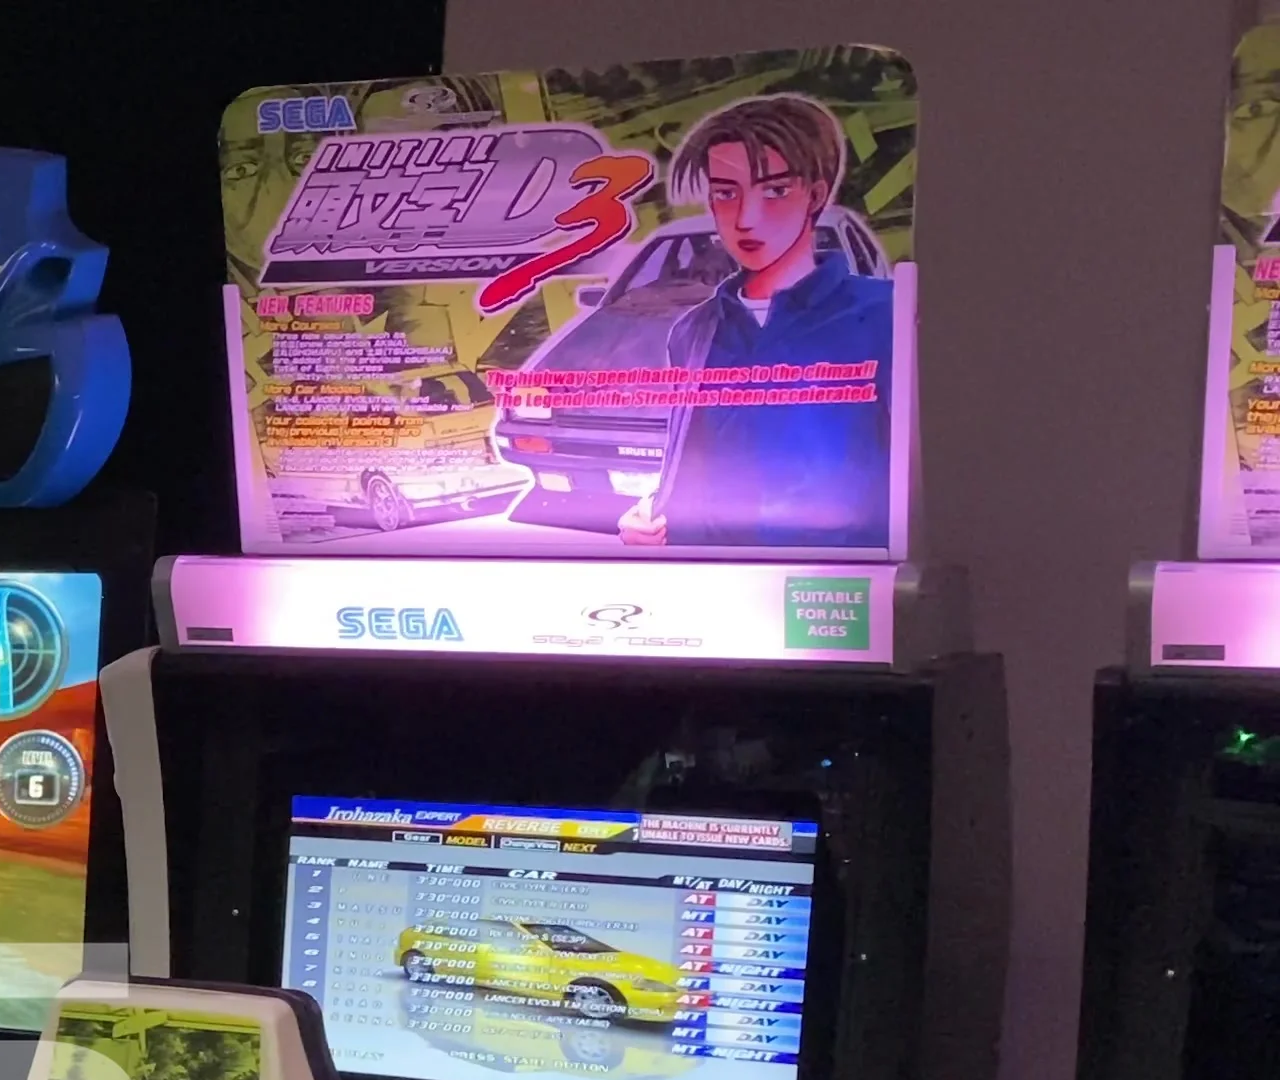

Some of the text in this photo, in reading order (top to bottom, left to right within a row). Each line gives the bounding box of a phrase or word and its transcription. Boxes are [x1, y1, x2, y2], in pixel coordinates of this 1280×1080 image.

[259, 98, 355, 131] SEGA
[315, 134, 501, 170] INITIAL
[364, 255, 515, 274] VERSION
[257, 294, 374, 316] NEW FEATURES
[517, 370, 586, 387] highway
[587, 369, 637, 386] speed
[692, 368, 750, 384] comes
[751, 365, 771, 383] to
[495, 392, 522, 409] The
[525, 391, 583, 409] Legend
[719, 387, 765, 406] been
[791, 590, 864, 605] SUITABLE
[796, 608, 858, 622] FOR ALL
[336, 607, 464, 642] SEGA
[807, 624, 848, 638] AGES
[28, 774, 45, 799] 6
[325, 805, 463, 825] Irohazaka EXPERT
[482, 818, 562, 834] REVERSE
[642, 818, 781, 836] THE MACHINE IS CURRENTLY
[445, 835, 488, 847] MODEL
[641, 829, 679, 841] UNABLE
[681, 831, 695, 842] TO
[697, 832, 723, 843] ISSUE
[725, 834, 749, 845] NEW
[562, 843, 598, 854] NEXT
[297, 855, 795, 897] RANK NAME TIME CAR MT/AT DAY/NIGHT
[683, 893, 713, 905] AT
[746, 897, 789, 908] DAY
[680, 910, 712, 922] MT
[745, 914, 788, 925] DAY
[681, 927, 710, 938] AT
[744, 932, 787, 943] DAY
[680, 944, 709, 954] AT
[743, 949, 786, 959] DAY
[679, 961, 708, 972] AT
[719, 963, 786, 977] NIGHT
[676, 977, 707, 988] MT
[740, 982, 783, 993] DAY
[484, 993, 528, 1004] LANCER
[674, 1011, 703, 1021] MT
[737, 1016, 780, 1026] DAY
[676, 994, 705, 1004] AT
[716, 996, 783, 1011] NIGHT
[672, 1027, 702, 1038] MT
[736, 1033, 778, 1043] DAY
[672, 1043, 702, 1054] MT
[712, 1047, 779, 1062] NIGHT
